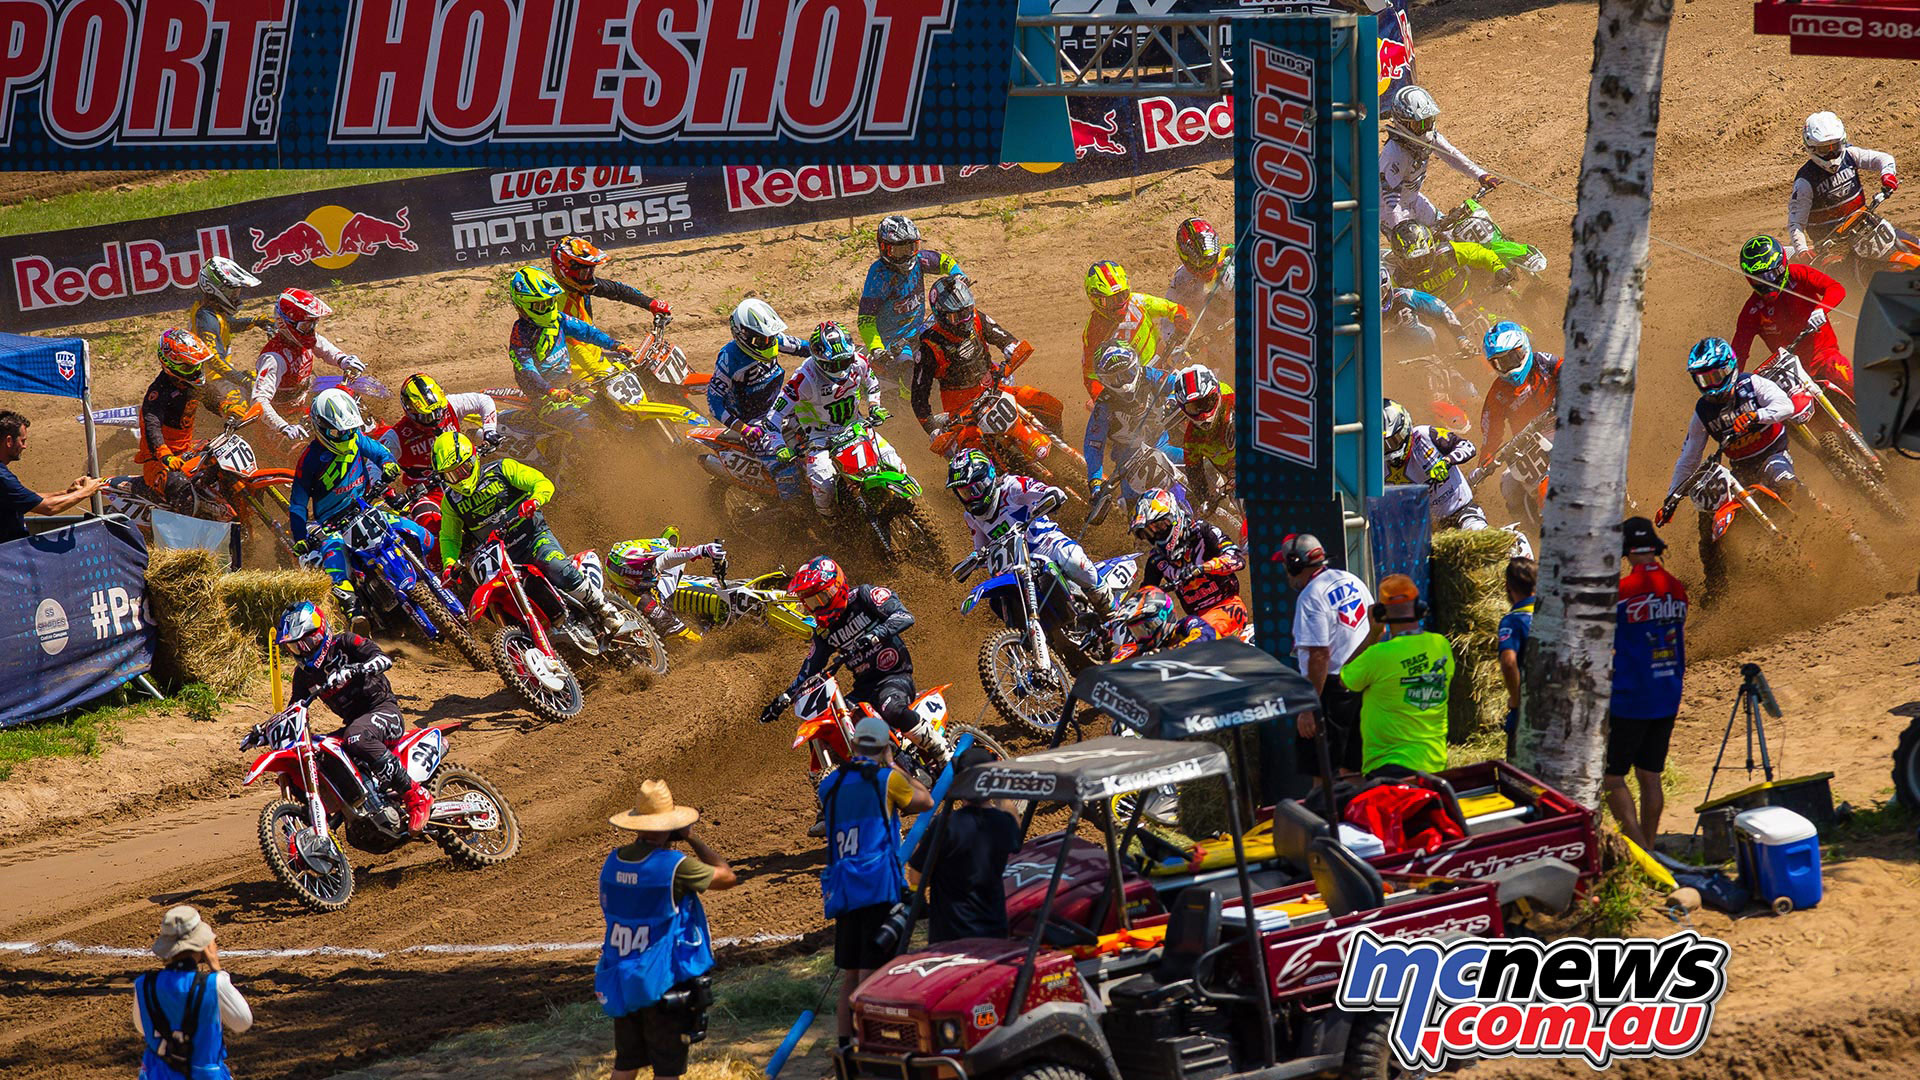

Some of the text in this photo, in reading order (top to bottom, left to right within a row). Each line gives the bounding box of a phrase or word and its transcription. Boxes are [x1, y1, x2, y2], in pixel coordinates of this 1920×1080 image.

[1791, 16, 1862, 37] mec
[332, 0, 953, 141] HOLESHOT
[1138, 95, 1235, 153] Red
[499, 166, 637, 200] LUCAS OIL
[723, 164, 836, 213] Red
[537, 194, 602, 211] PRO
[452, 194, 692, 250] MOTOCROSS
[456, 221, 694, 262] CHAMPONSHIP
[12, 225, 234, 312] Red Bull
[612, 375, 644, 403] 39
[985, 397, 1018, 434] 60
[224, 440, 255, 473] 776
[851, 443, 868, 470] 1
[1112, 564, 1132, 585] 51
[837, 612, 871, 642] RACING
[801, 681, 832, 718] 4
[924, 698, 943, 714] 4
[1184, 697, 1287, 733] Kawasaki
[1102, 758, 1202, 796] Kawasaki
[977, 1013, 995, 1027] 66
